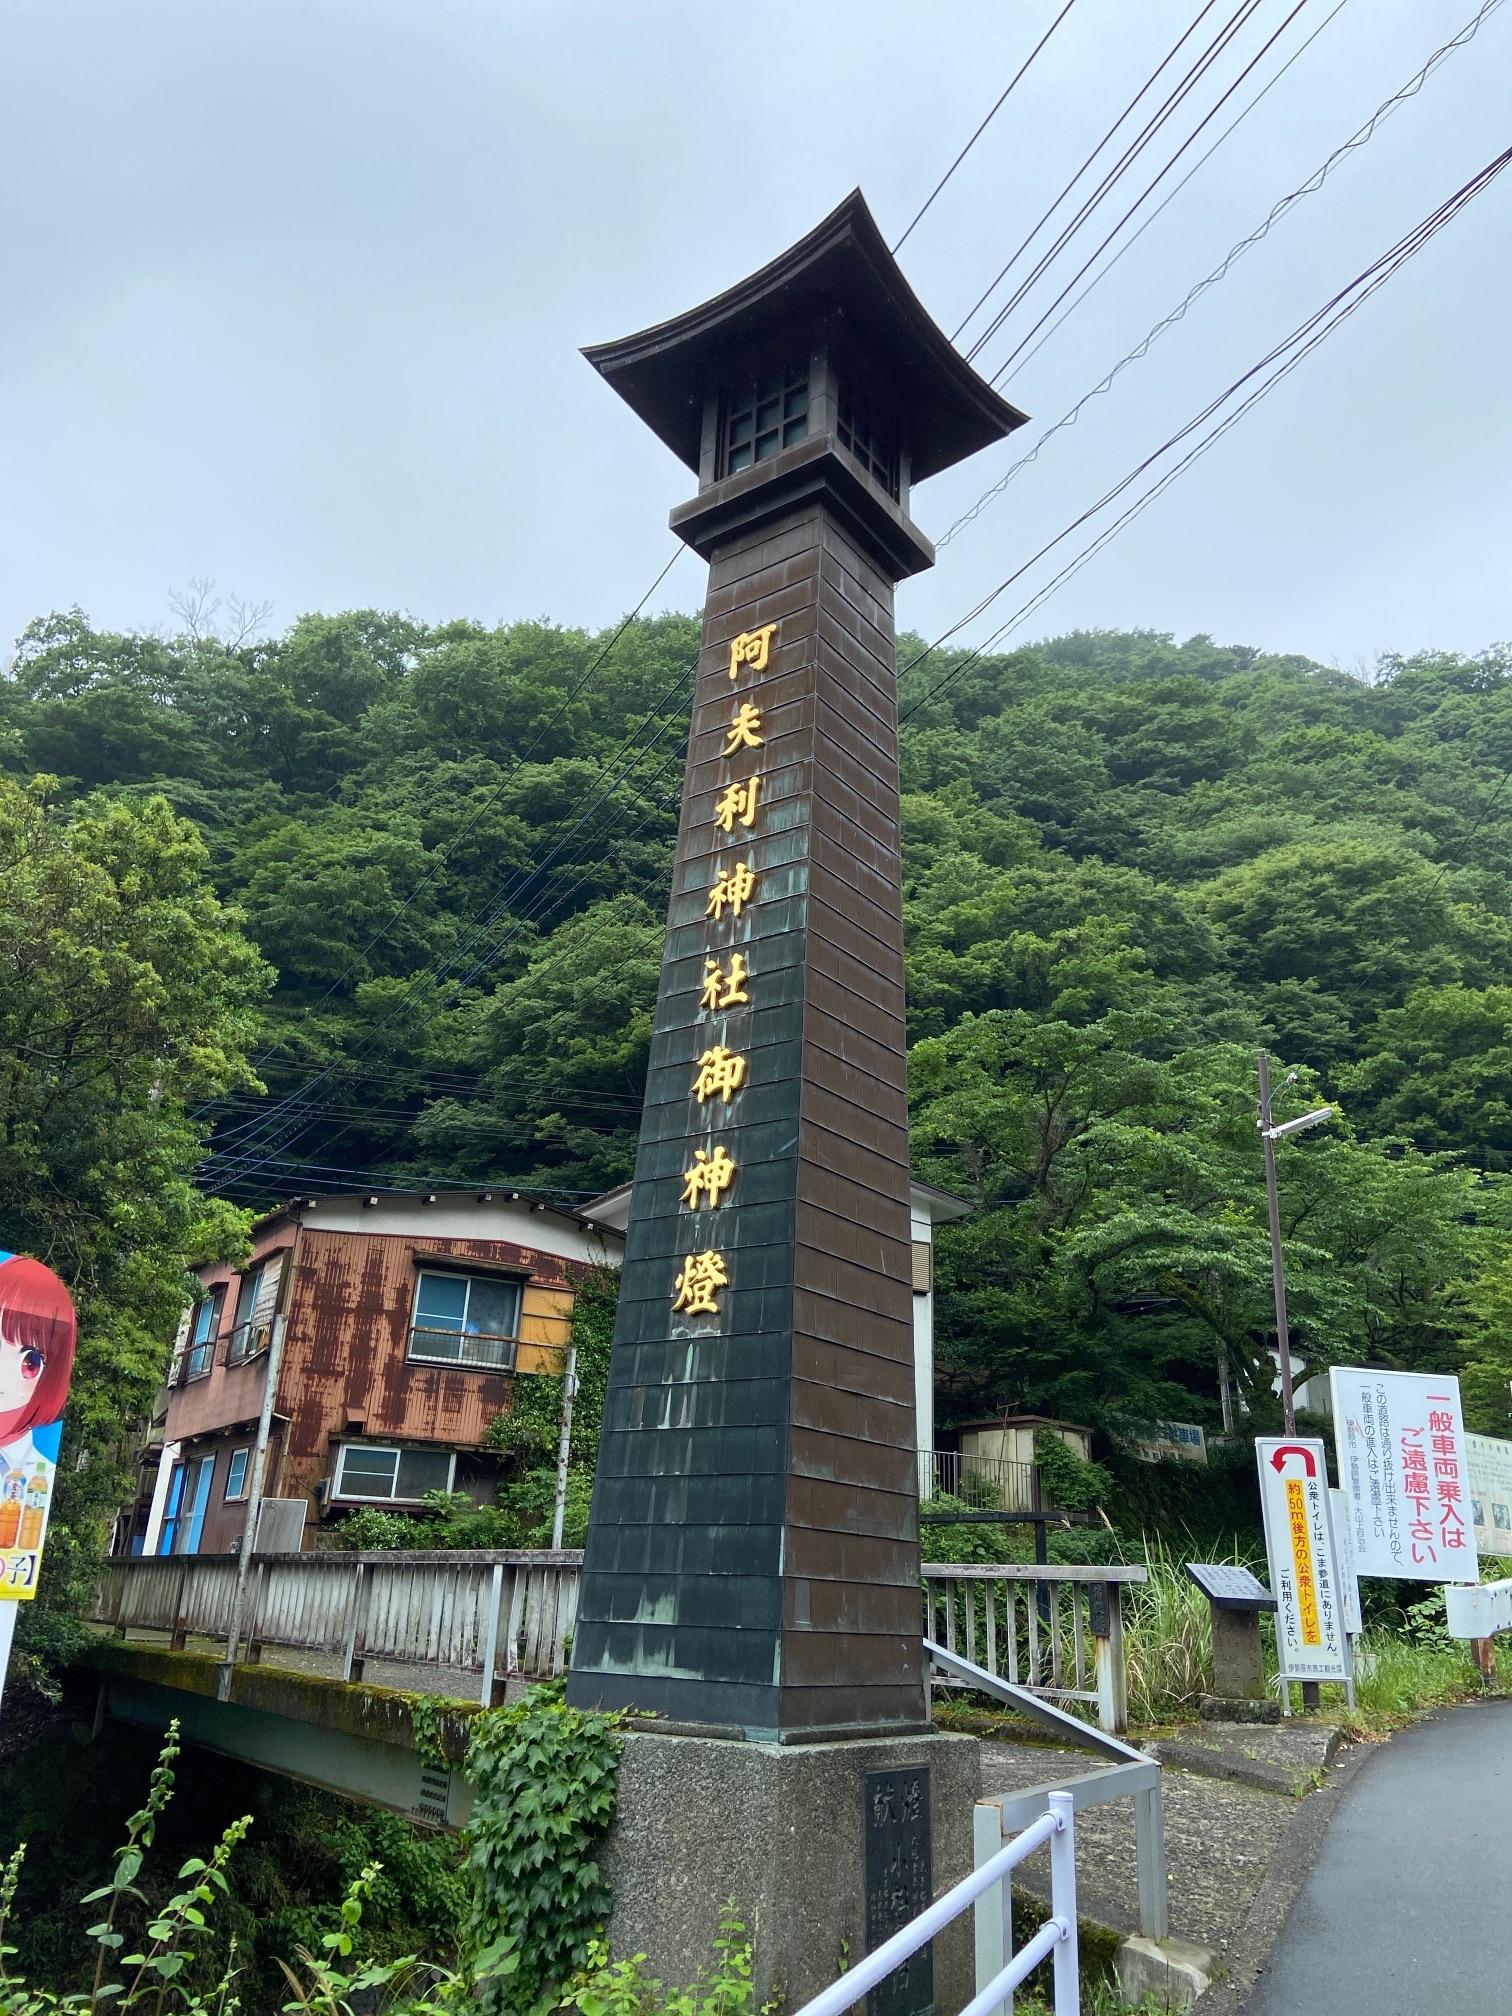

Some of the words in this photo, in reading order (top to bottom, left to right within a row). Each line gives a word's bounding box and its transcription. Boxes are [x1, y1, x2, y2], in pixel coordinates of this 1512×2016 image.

[670, 622, 777, 1315] 阿夫利神社御神燈
[1360, 1385, 1385, 1538] 一般車両の進入はご遠慮下さい
[1376, 1383, 1404, 1566] この道路は通り抜け出来ませんので、
[1401, 1427, 1437, 1564] ご遠慮下さい
[1426, 1395, 1466, 1549] 一般車両乗入は
[1281, 1569, 1299, 1652] ご利用ください。
[1288, 1483, 1317, 1642] 約50m後方の公衆トイレを
[1308, 1481, 1338, 1657] 公衆トイレは、こま参道にありません。
